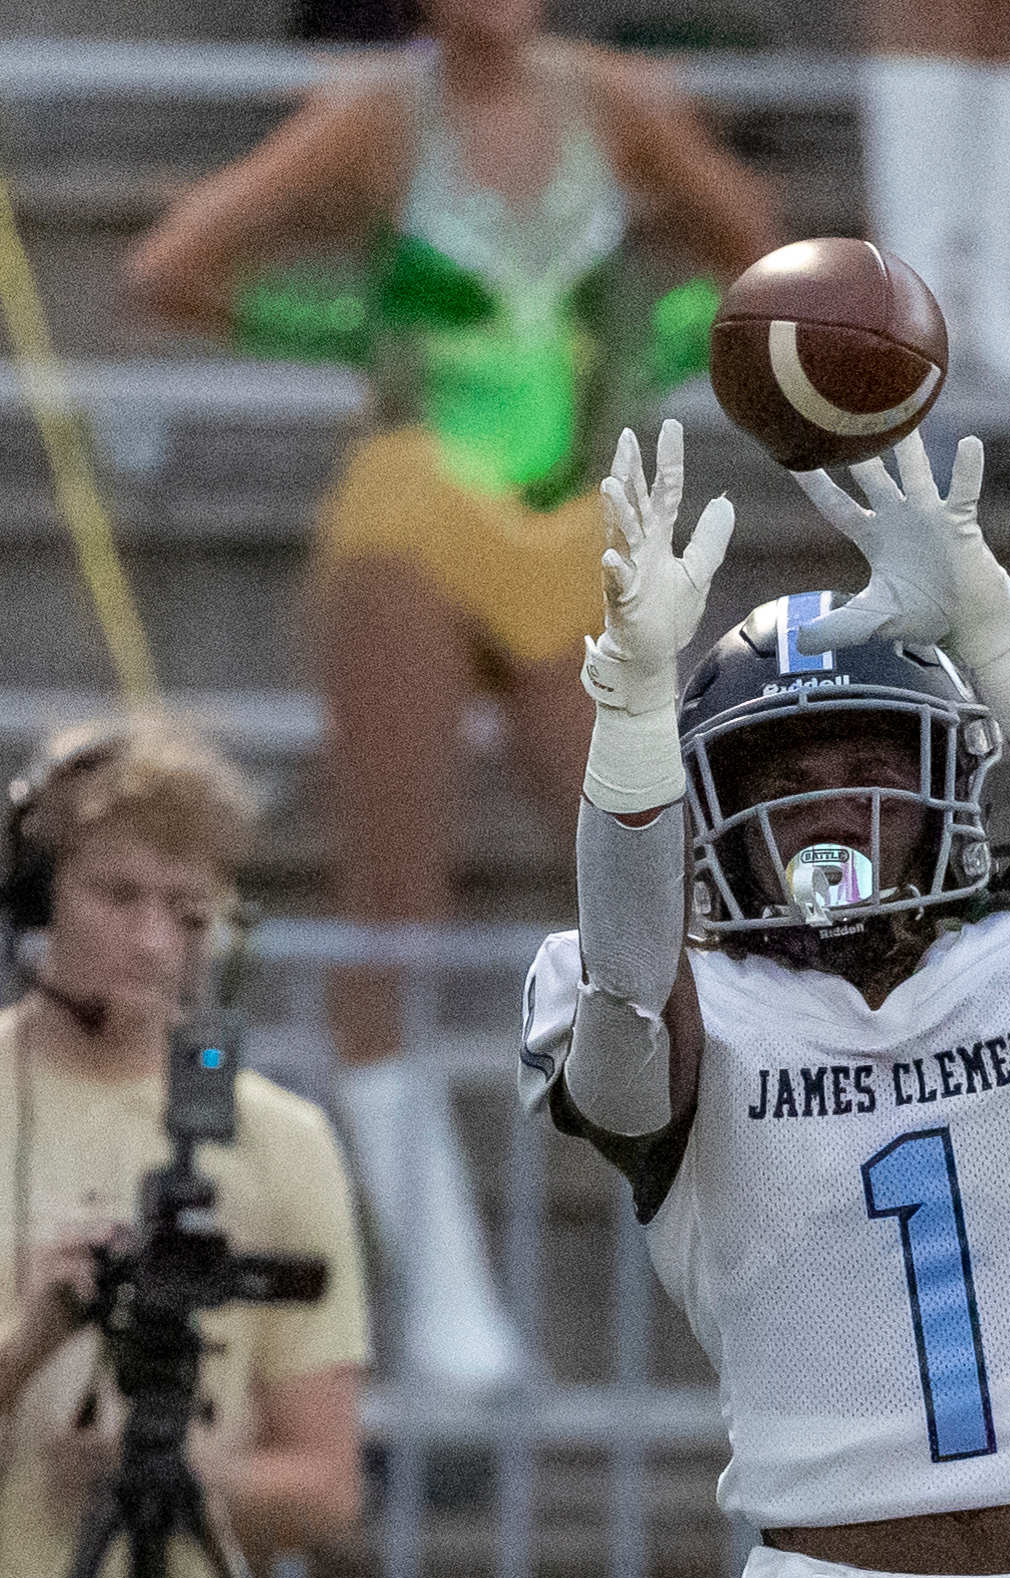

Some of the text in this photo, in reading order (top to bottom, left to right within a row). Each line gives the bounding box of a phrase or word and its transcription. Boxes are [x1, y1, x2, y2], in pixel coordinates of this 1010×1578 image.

[804, 851, 847, 861] BATTLE
[748, 1065, 877, 1119] JAMES
[861, 1126, 997, 1463] 1
